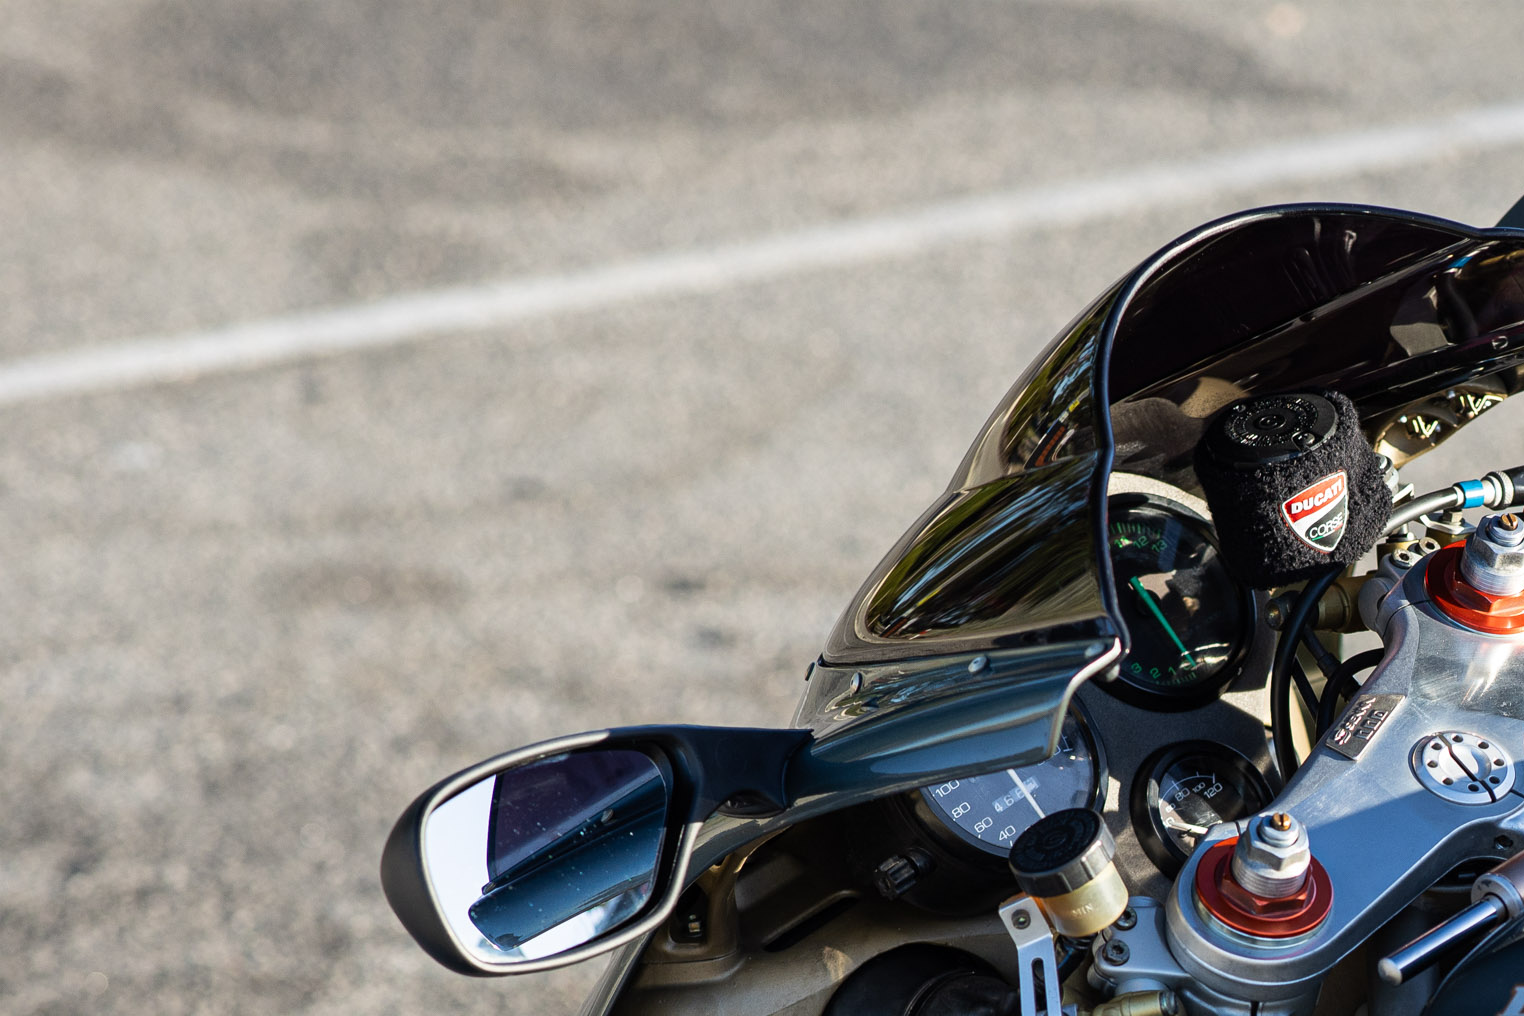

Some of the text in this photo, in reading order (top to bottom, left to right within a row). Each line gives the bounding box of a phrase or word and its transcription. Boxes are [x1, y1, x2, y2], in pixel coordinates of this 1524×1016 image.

[1291, 479, 1343, 515] DUCATI
[1309, 512, 1344, 539] CORSE
[1133, 535, 1149, 549] 12
[1152, 539, 1168, 552] 13
[1131, 662, 1143, 674] 3
[1149, 667, 1161, 679] 2
[1168, 666, 1177, 676] 1
[935, 778, 960, 798] 100
[1174, 787, 1191, 802] 80
[1191, 782, 1206, 794] 100
[1203, 782, 1223, 799] 120
[951, 801, 971, 820] 80
[974, 816, 994, 833] 60
[998, 825, 1016, 841] 40
[1072, 903, 1094, 916] MIN
